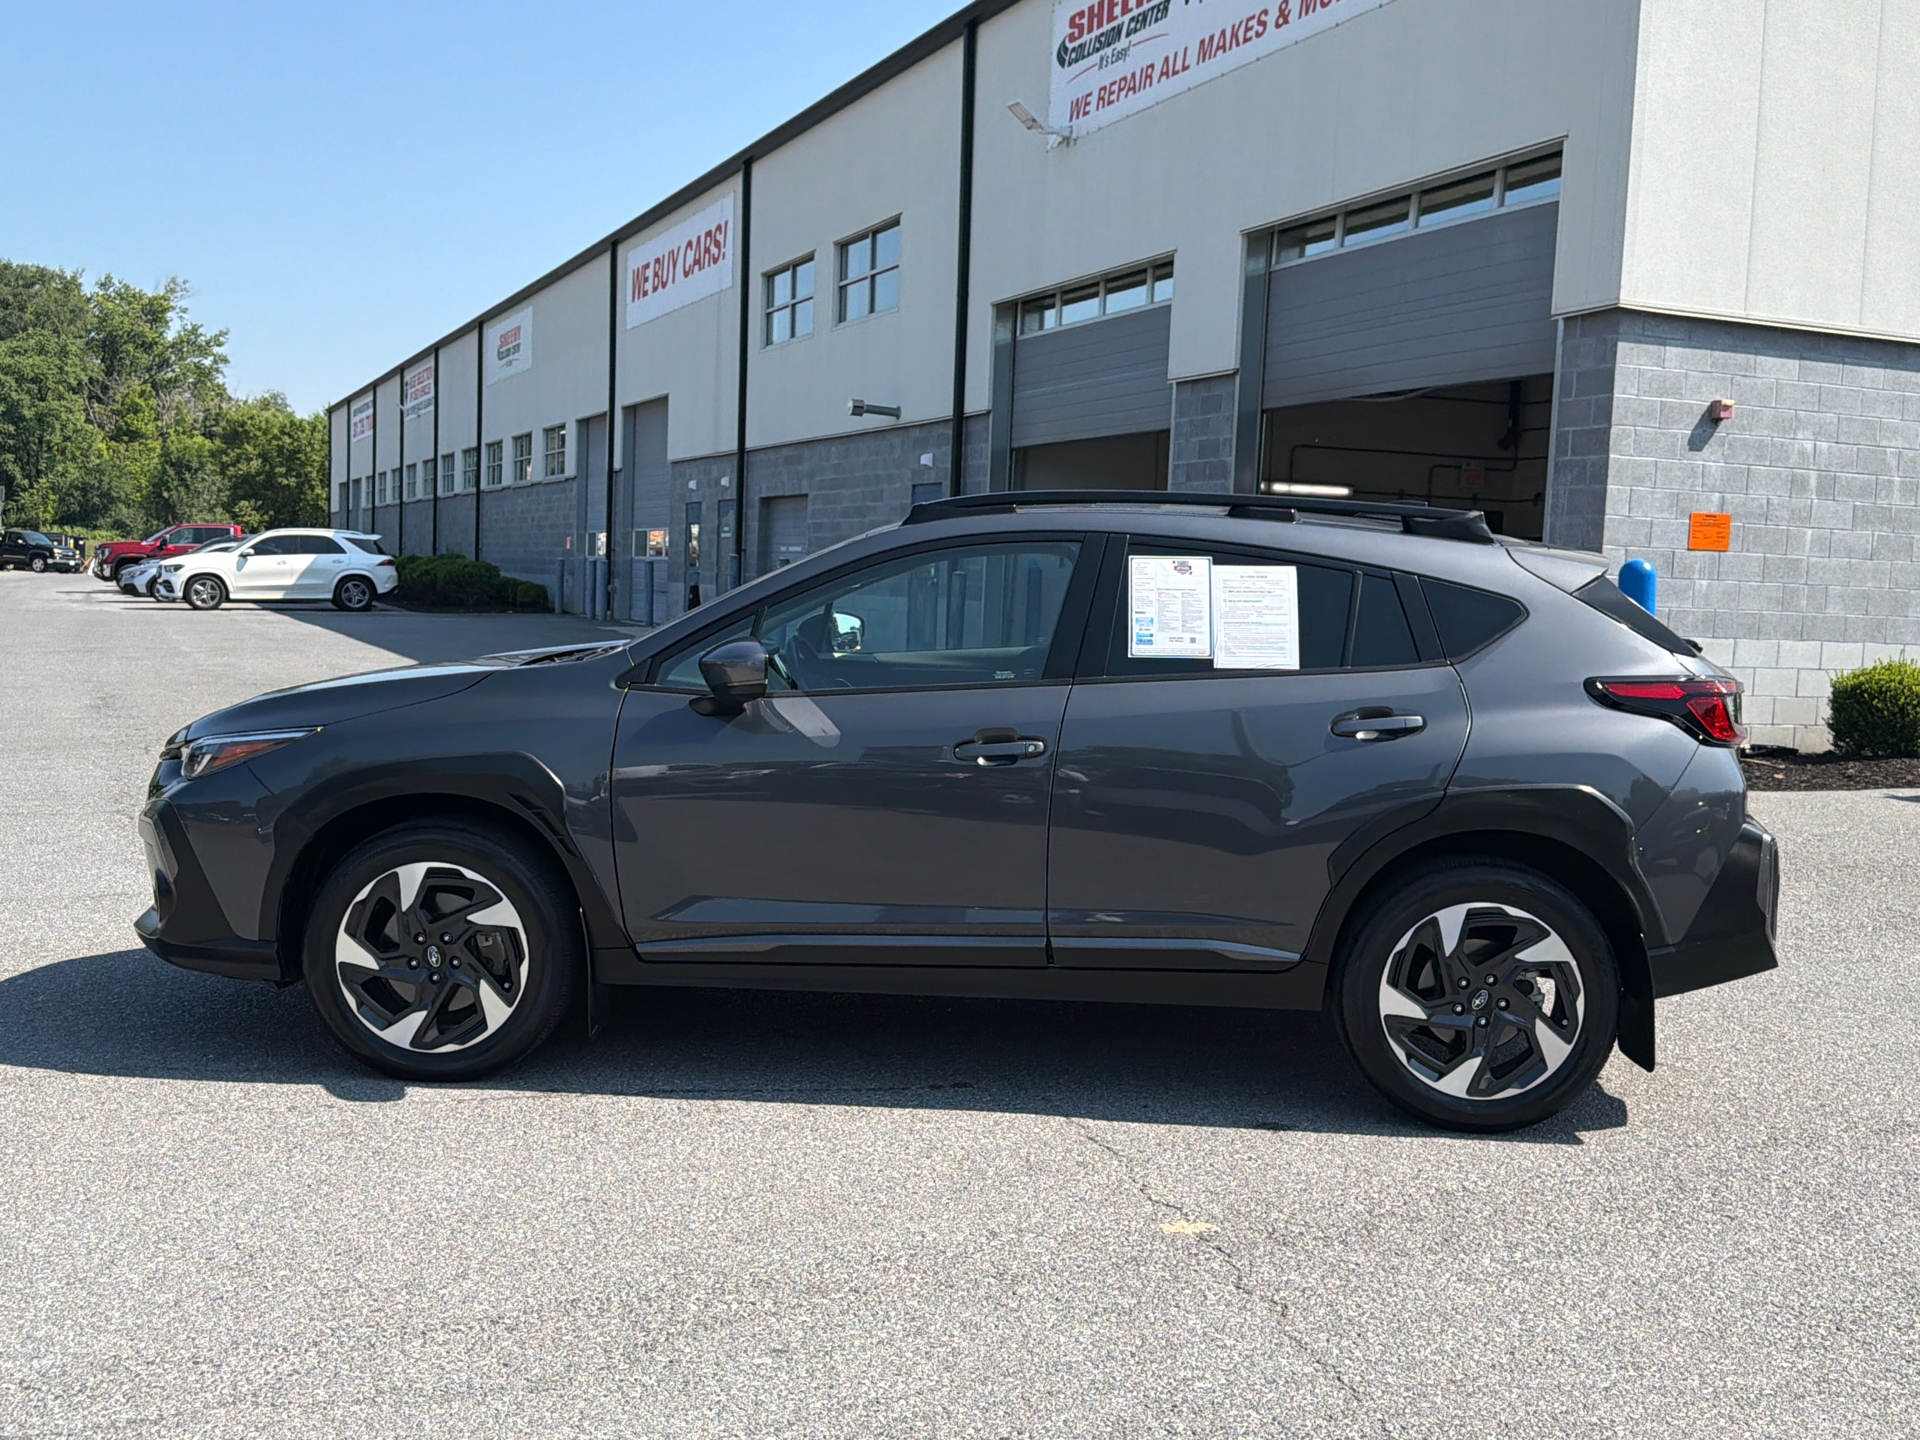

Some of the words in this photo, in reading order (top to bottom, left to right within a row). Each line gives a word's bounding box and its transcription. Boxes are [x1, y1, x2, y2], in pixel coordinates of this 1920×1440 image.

[1067, 21, 1125, 68] COLLISION
[1125, 0, 1171, 39] CENTER
[1069, 91, 1093, 123] WE
[1096, 62, 1155, 112] REPAIR
[1157, 46, 1190, 84] ALL
[1196, 8, 1269, 66] MAKES
[1274, 0, 1292, 29] &
[632, 261, 650, 303] WE
[652, 245, 681, 294] BUY
[682, 220, 729, 279] CARS!
